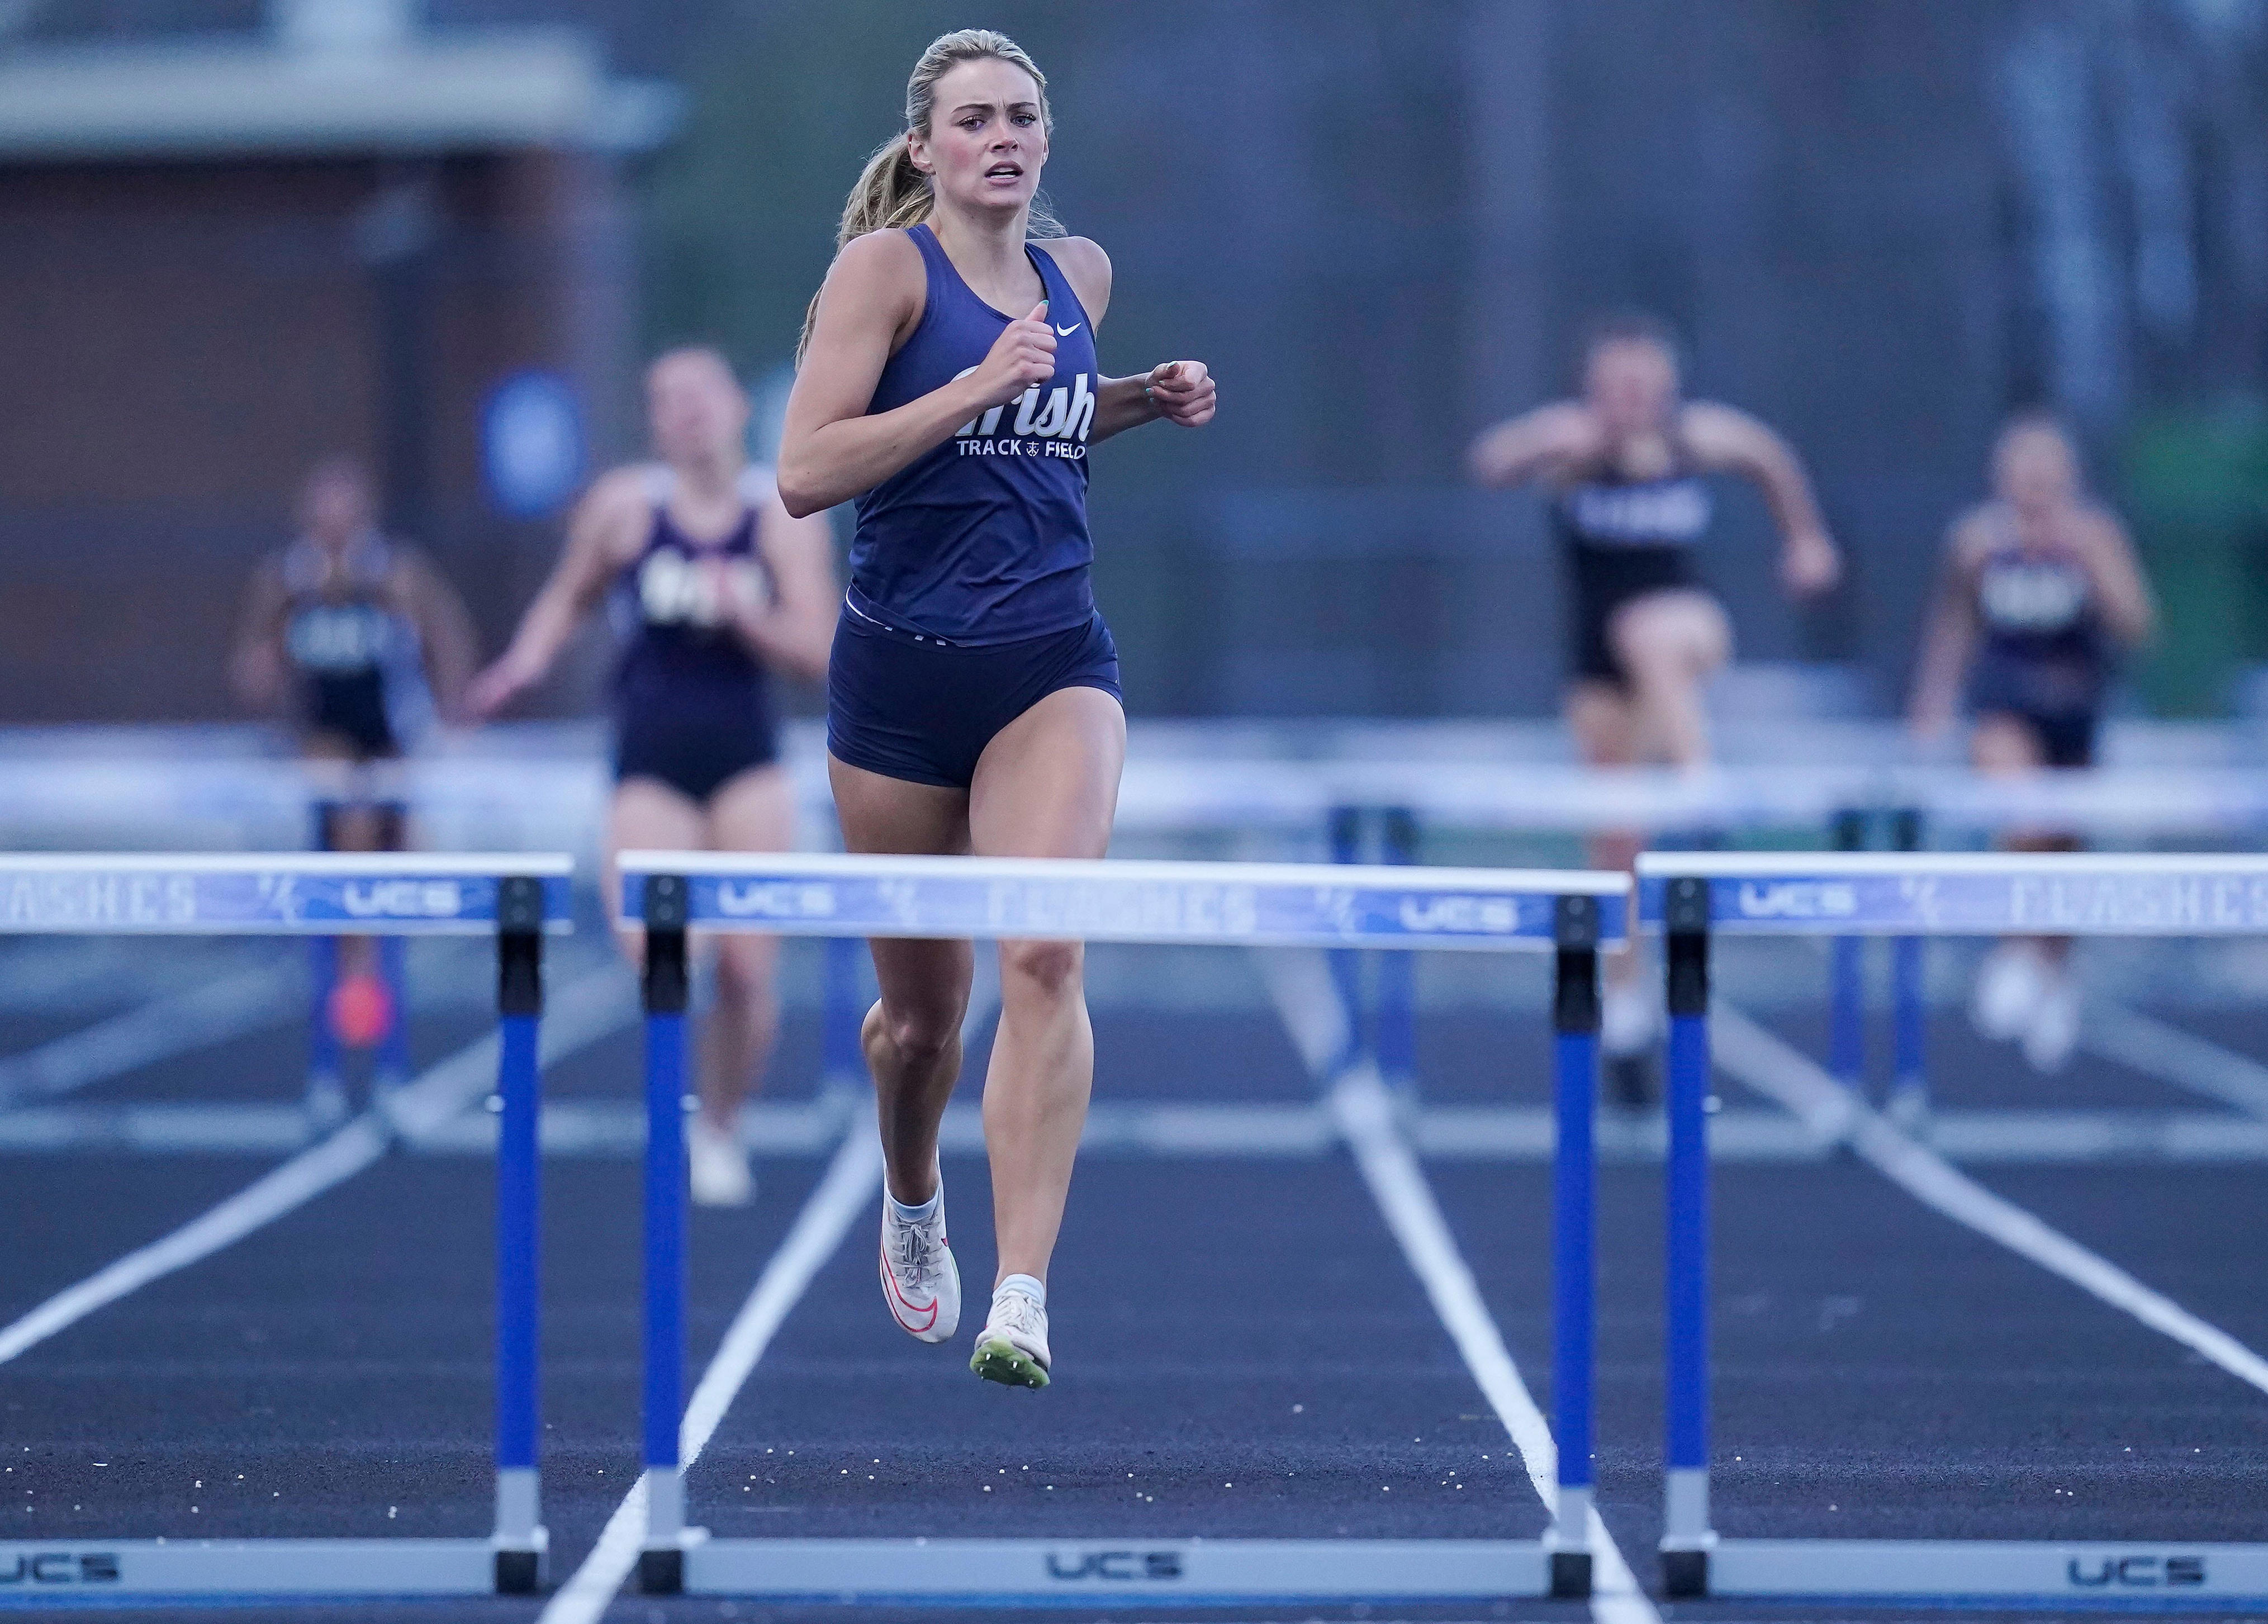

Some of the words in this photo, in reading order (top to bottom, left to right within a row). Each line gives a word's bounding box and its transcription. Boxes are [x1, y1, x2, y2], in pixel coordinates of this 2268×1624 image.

[950, 364, 1095, 442] rish
[956, 439, 1022, 457] TRACK
[1045, 440, 1086, 460] FIELD
[342, 880, 463, 917] UCS
[717, 879, 836, 917] UCS
[1398, 895, 1519, 933] UCS
[1739, 880, 1858, 917] UCS
[1044, 1551, 1183, 1581] UCS
[2067, 1555, 2207, 1586] UCS
